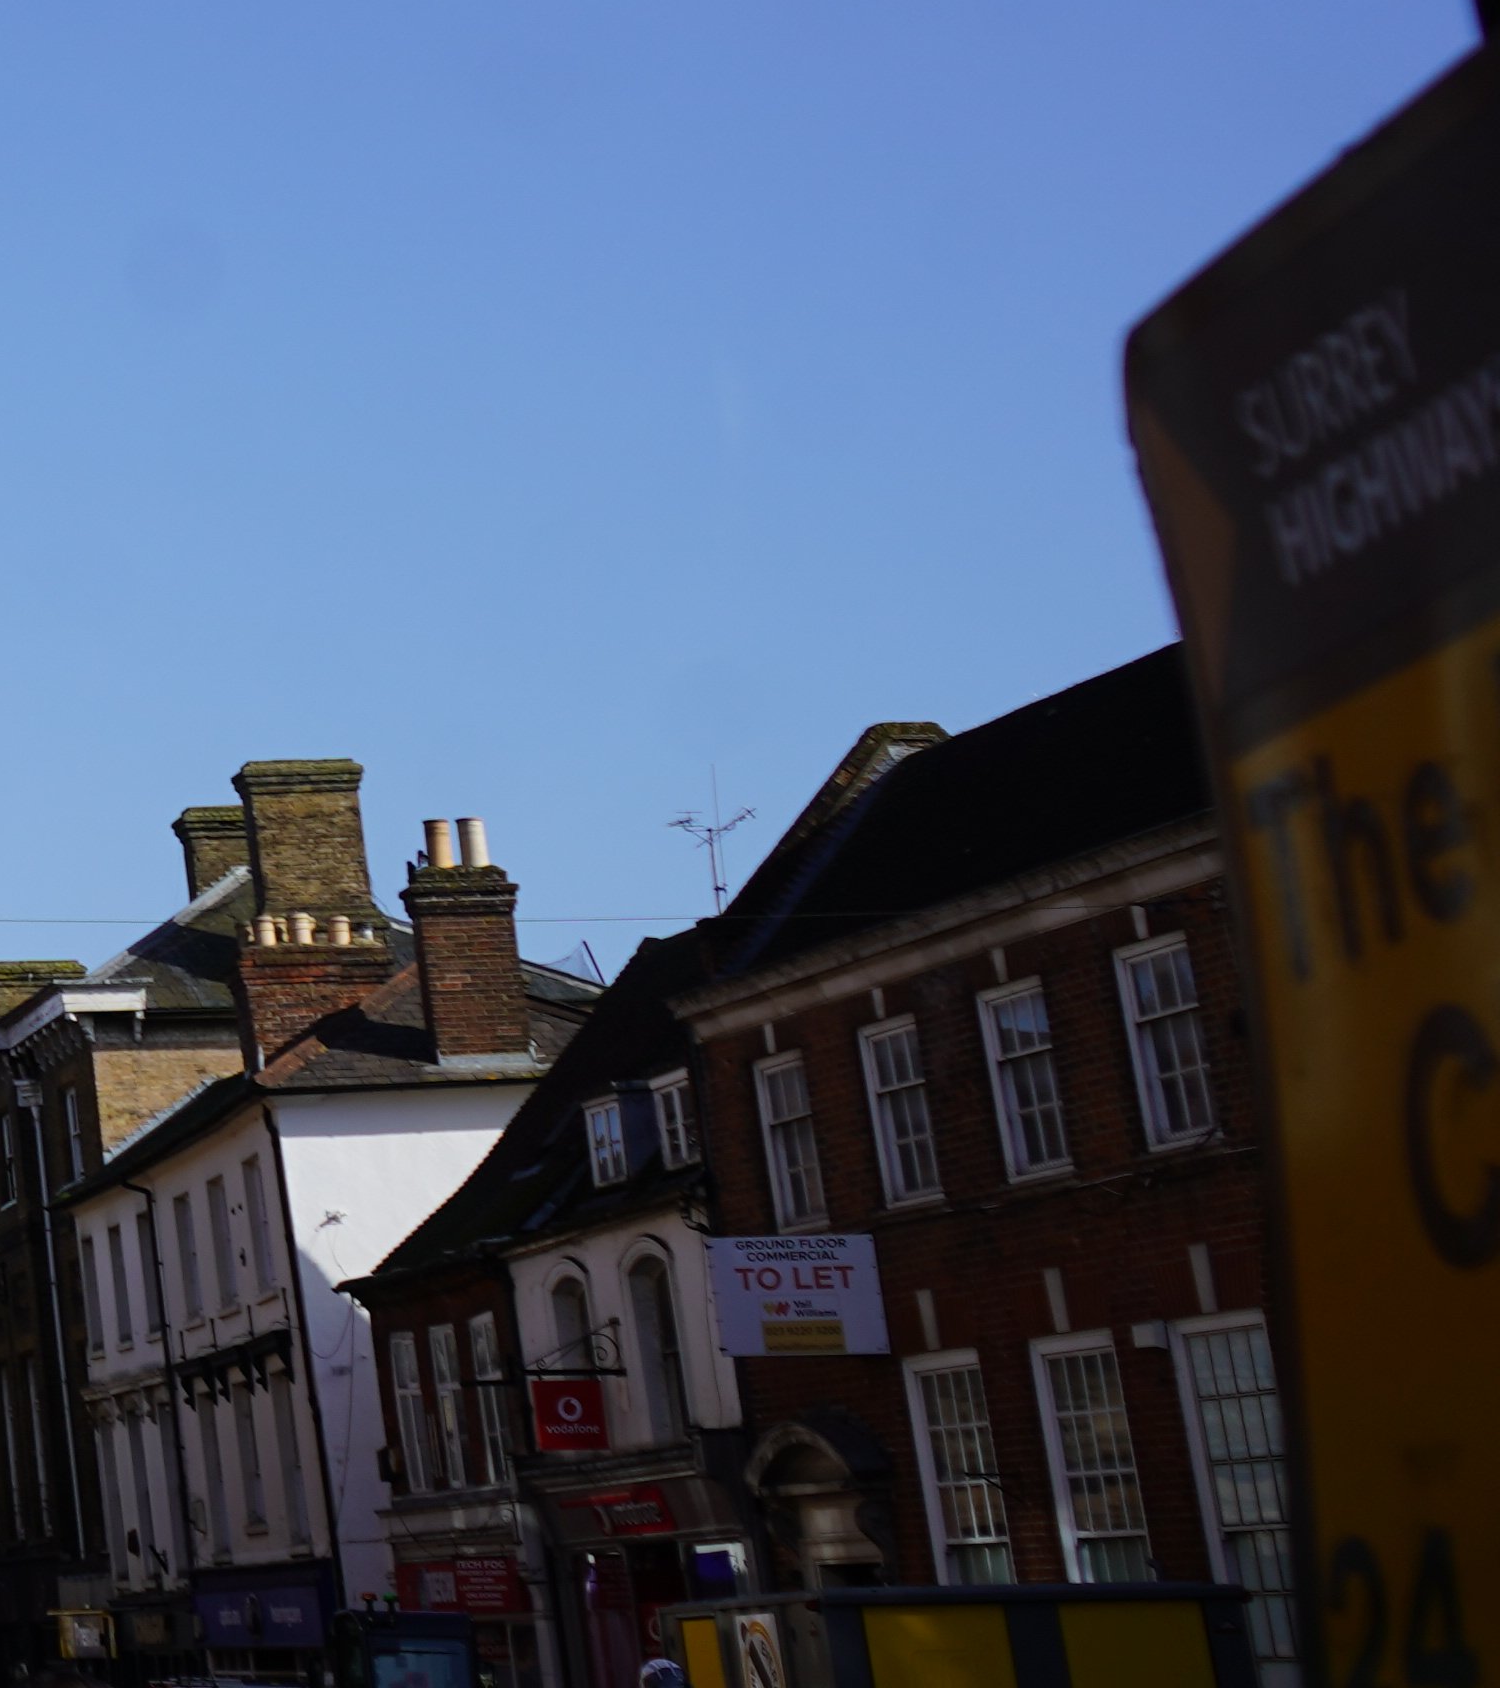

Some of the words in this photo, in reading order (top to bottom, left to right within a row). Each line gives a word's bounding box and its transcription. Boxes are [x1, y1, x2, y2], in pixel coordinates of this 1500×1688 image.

[1235, 289, 1418, 481] SURREY
[1248, 752, 1476, 984] The
[735, 1239, 795, 1251] GROUND
[799, 1238, 848, 1249] FLOOR
[746, 1250, 840, 1262] COMMERCIAL
[733, 1266, 782, 1291] TO
[791, 1265, 855, 1290] LET
[545, 1423, 601, 1435] vodafone
